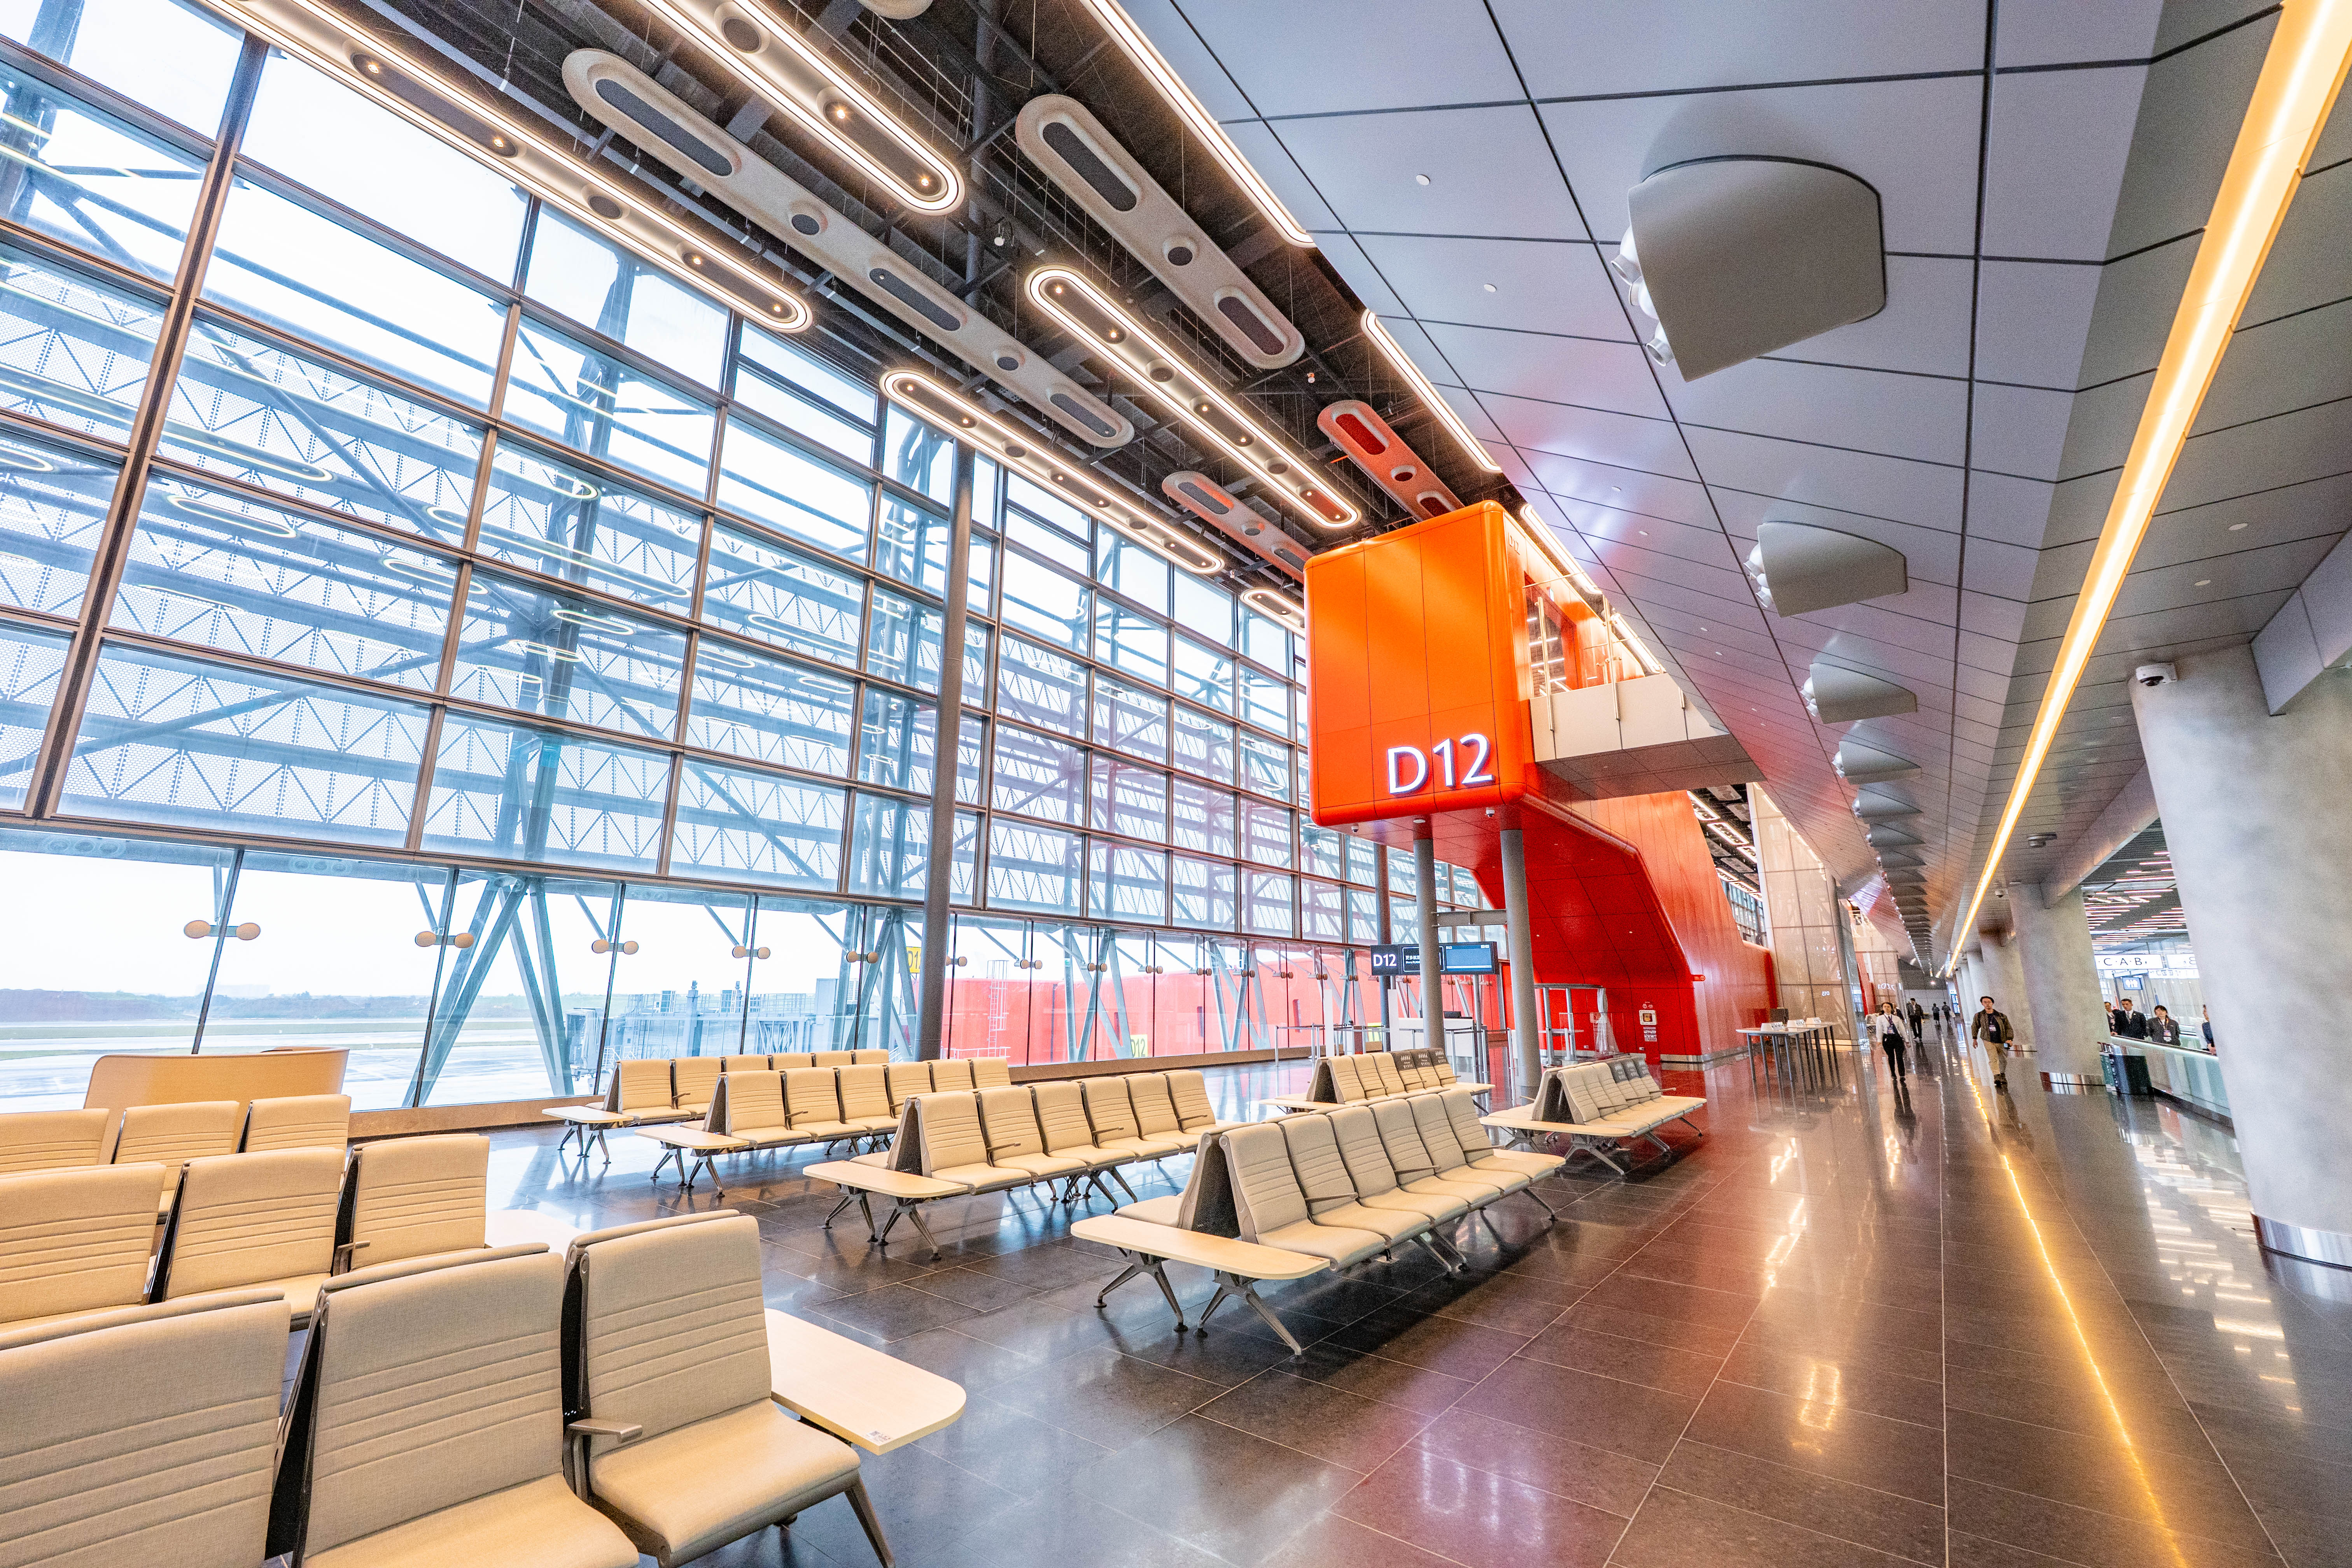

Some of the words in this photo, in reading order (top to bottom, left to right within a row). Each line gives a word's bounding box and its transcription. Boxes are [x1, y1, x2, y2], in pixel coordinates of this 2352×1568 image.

[1388, 733, 1494, 795] D12
[907, 951, 921, 969] D1
[1373, 954, 1397, 966] D12
